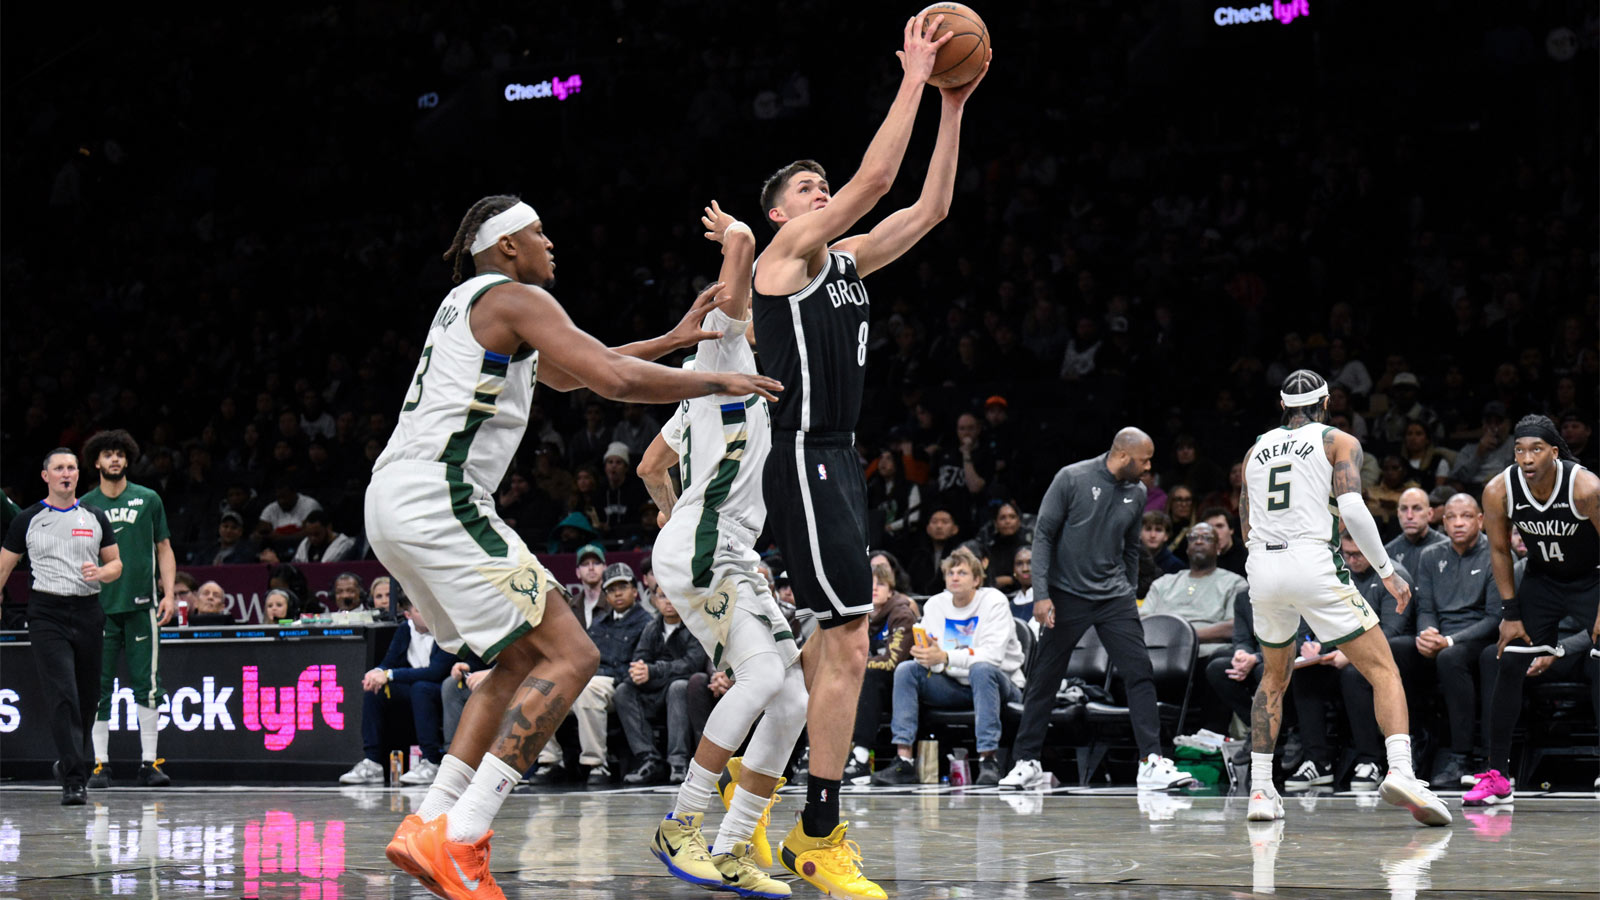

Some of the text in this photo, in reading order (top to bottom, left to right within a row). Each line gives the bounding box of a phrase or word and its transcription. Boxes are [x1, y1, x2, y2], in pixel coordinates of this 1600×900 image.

[1214, 0, 1310, 26] Check lyft
[504, 79, 552, 102] Check
[826, 280, 870, 309] BRO
[857, 321, 869, 367] 8
[1254, 440, 1315, 466] TRENT JR
[1267, 463, 1293, 512] 5
[104, 507, 138, 525] CKS
[1537, 540, 1565, 562] 14
[109, 664, 345, 751] heck lyft
